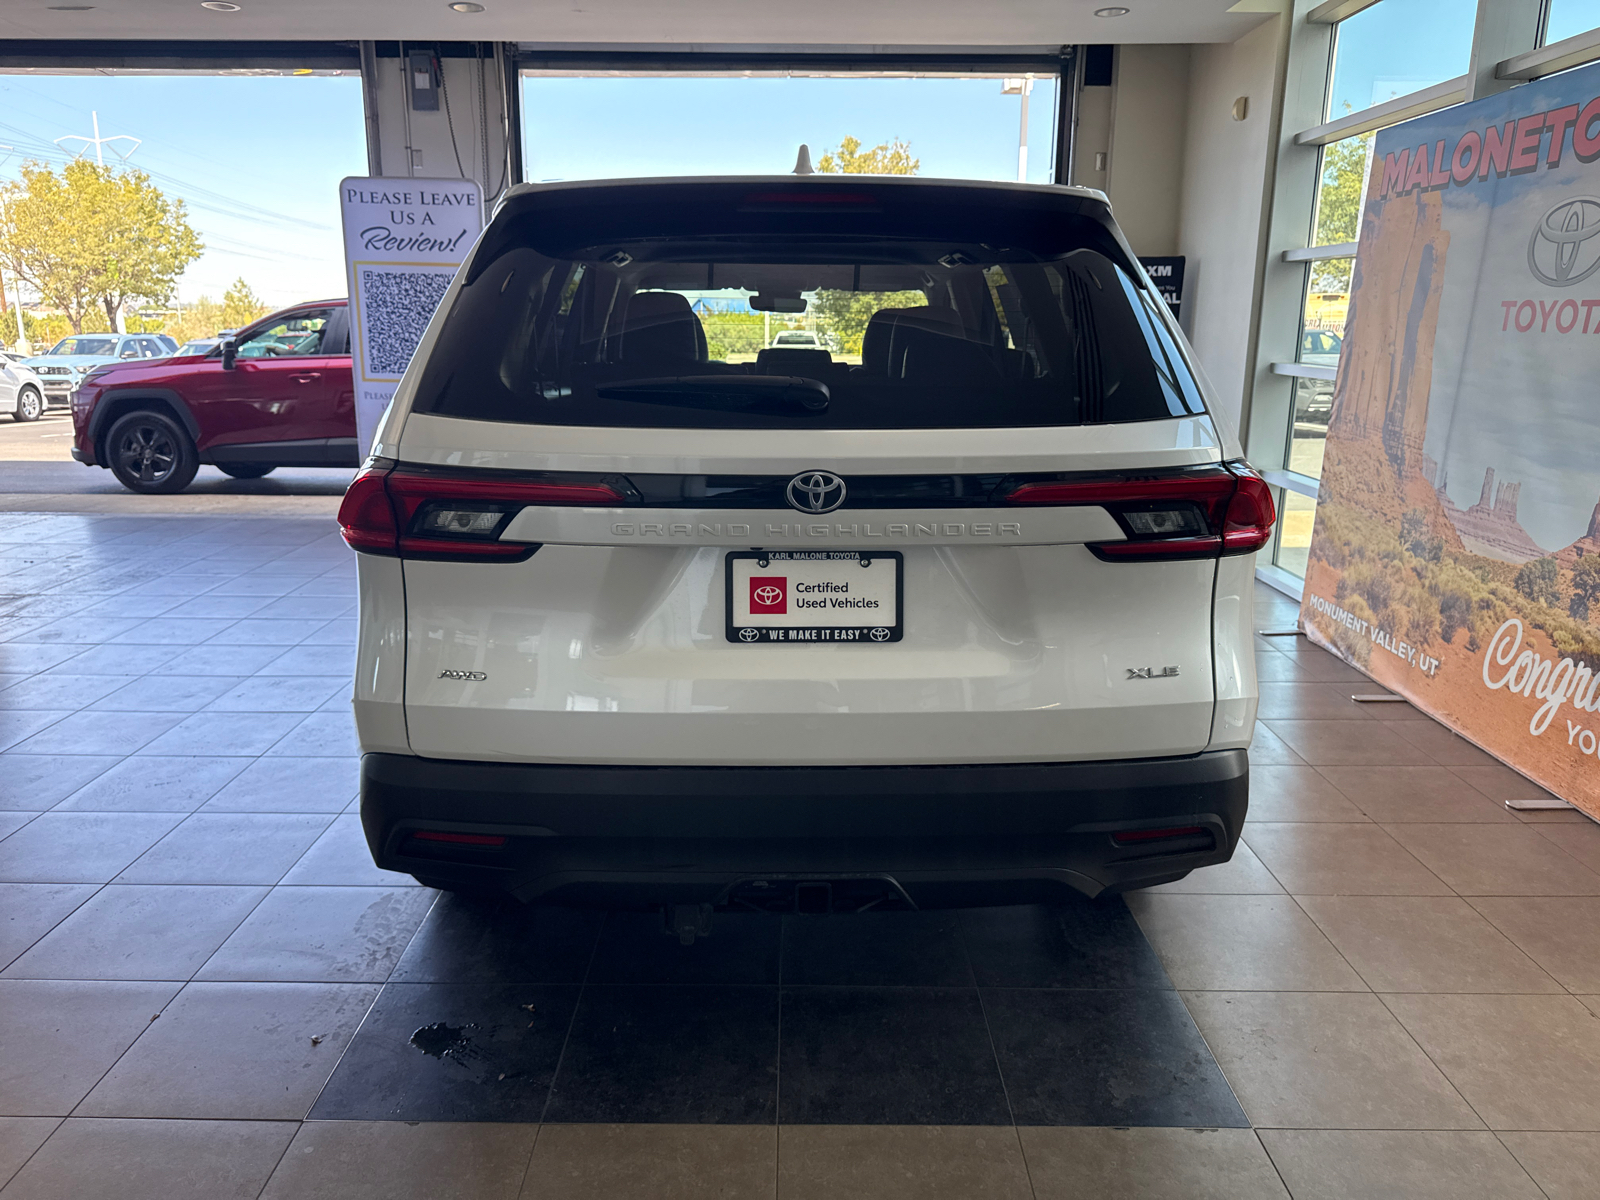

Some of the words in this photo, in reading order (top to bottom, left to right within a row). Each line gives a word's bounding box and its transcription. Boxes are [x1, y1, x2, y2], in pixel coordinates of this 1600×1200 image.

[421, 211, 436, 226] A
[359, 226, 468, 253] Review!
[610, 522, 751, 538] GRAND
[765, 521, 1022, 538] HIGHLANDER
[768, 552, 791, 560] KARL
[792, 552, 827, 560] MALONE
[828, 552, 861, 560] TOYOTA
[795, 581, 849, 593] Certified
[796, 597, 827, 609] Used
[829, 597, 880, 609] Vehicles
[769, 629, 785, 640] WE
[788, 629, 818, 640] MAKE
[821, 629, 831, 640] IT
[834, 629, 861, 640] EASY
[1309, 593, 1369, 636] MONUMENT
[1370, 625, 1416, 668] VALLEY,
[1419, 652, 1440, 676] UT
[436, 669, 488, 682] AWD
[1125, 664, 1182, 681] XLE
[1566, 719, 1600, 760] YO
